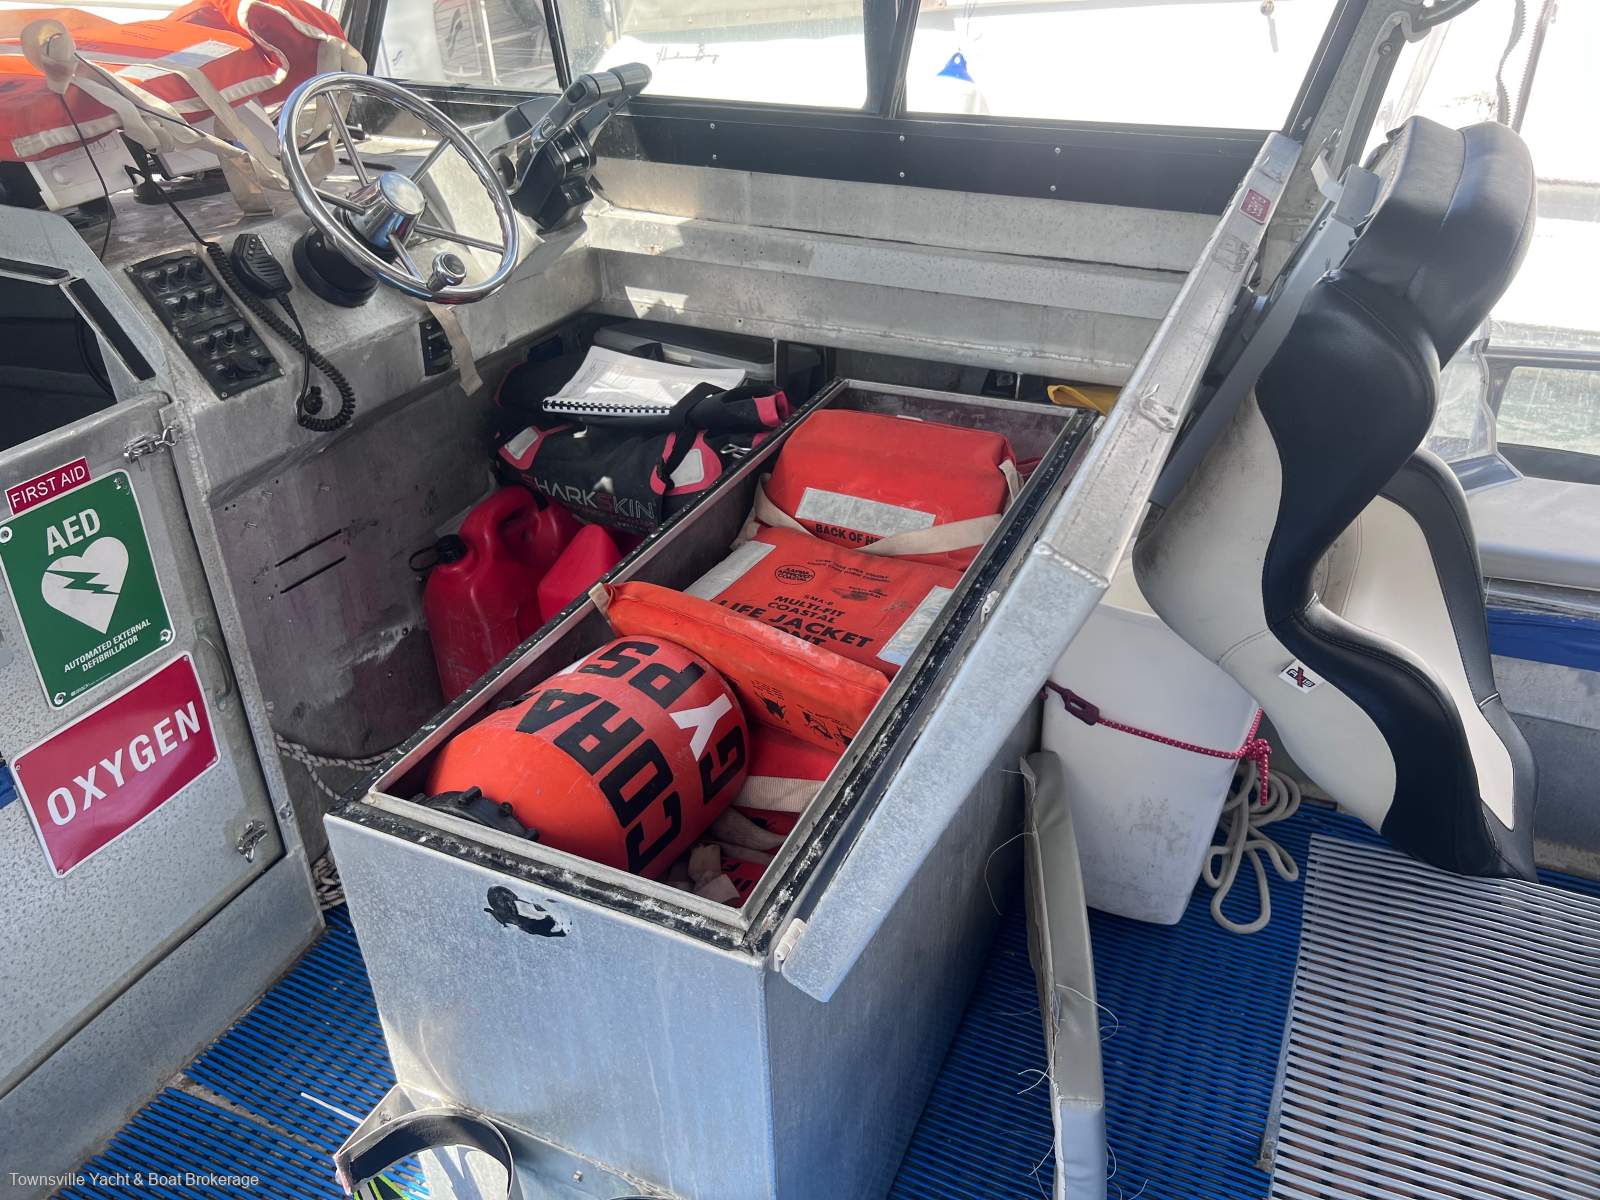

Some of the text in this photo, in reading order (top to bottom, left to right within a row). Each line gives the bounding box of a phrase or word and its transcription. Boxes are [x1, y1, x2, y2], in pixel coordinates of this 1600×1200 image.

[10, 465, 86, 508] FIRST AID
[46, 508, 101, 556] AED
[815, 523, 846, 540] BACK
[848, 531, 863, 544] OF
[768, 602, 838, 624] COASTAL
[773, 595, 846, 618] MULTI-FIT
[64, 618, 152, 673] AUTOMATED EXTERNAL
[768, 614, 875, 648] JACKET
[81, 634, 139, 672] DEFIBRILLATOR
[560, 641, 746, 806] GYPS
[47, 700, 201, 826] OXYGEN
[500, 688, 682, 874] CORA
